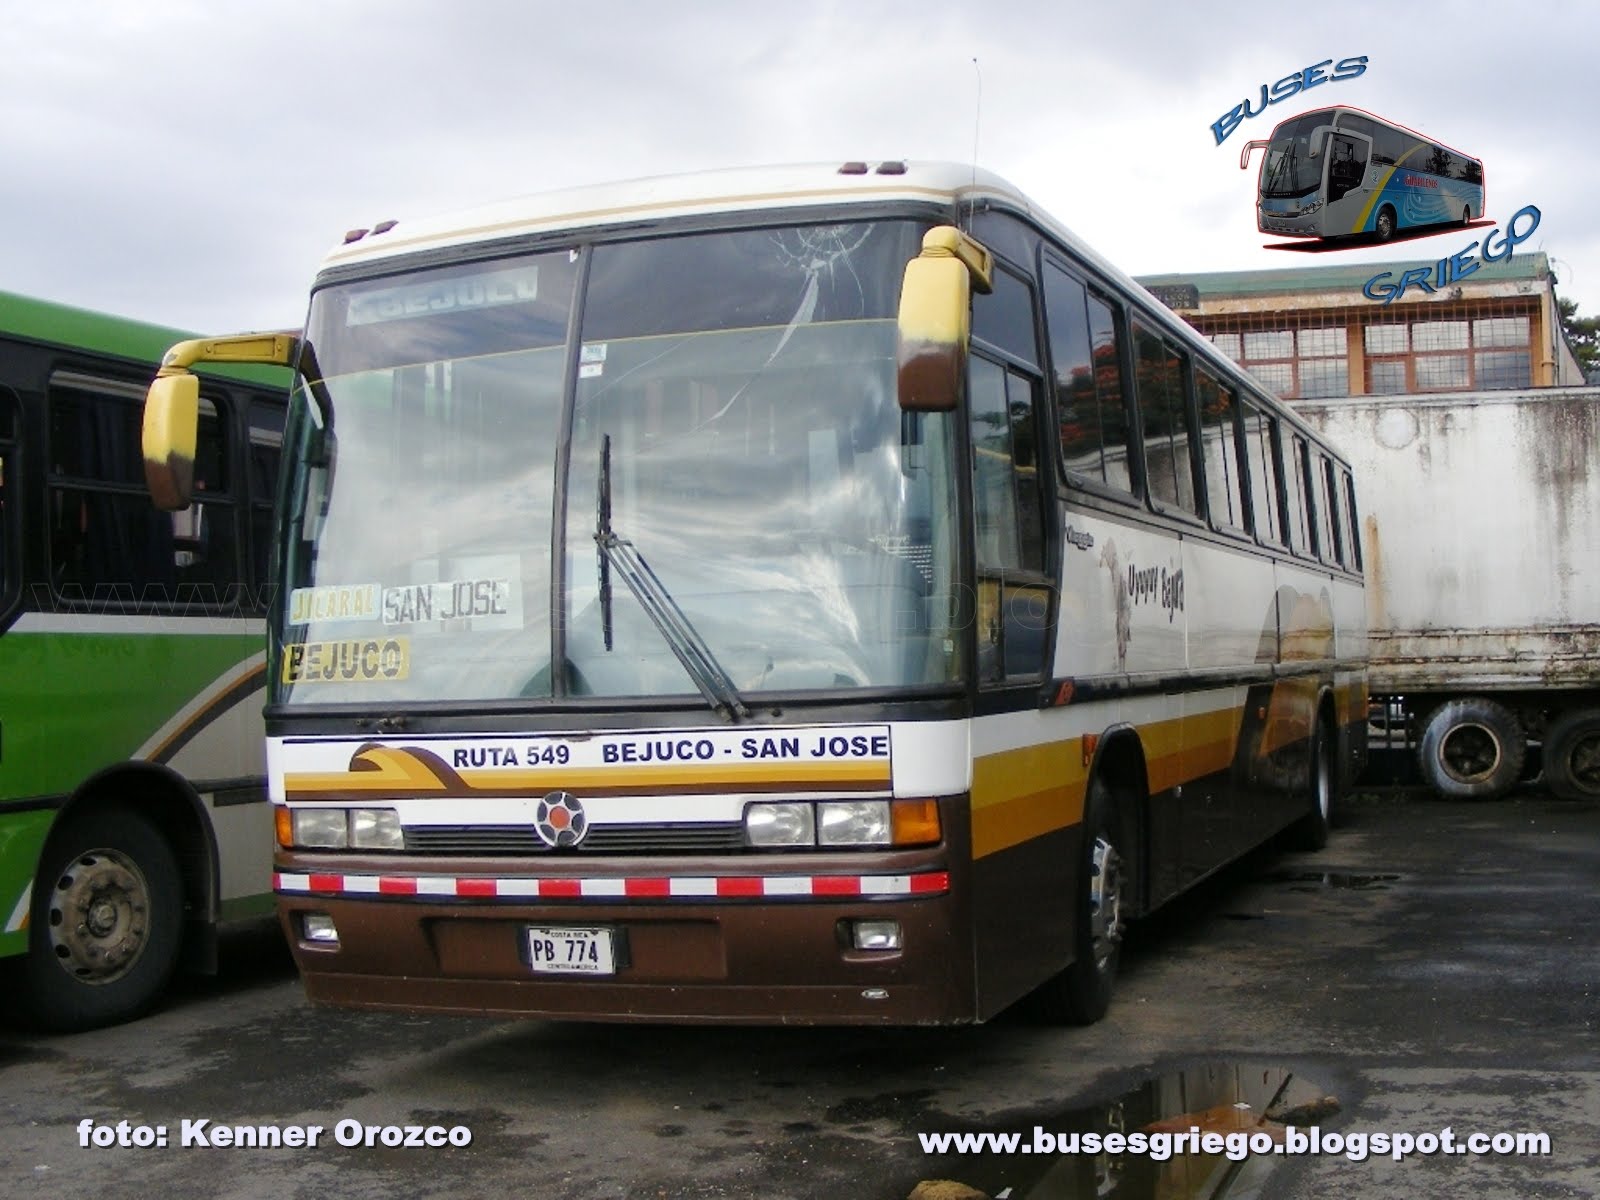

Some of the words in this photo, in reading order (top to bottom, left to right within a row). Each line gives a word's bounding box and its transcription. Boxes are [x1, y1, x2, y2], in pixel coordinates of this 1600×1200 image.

[385, 584, 432, 624] SAN
[441, 579, 507, 620] JOSE
[289, 640, 401, 681] BEJUCO
[454, 747, 518, 767] RUTA
[527, 744, 570, 765] 549
[603, 740, 714, 763] BEJUCO
[742, 738, 799, 758] SAN
[811, 736, 888, 757] JOSE
[533, 940, 555, 961] PB
[565, 940, 598, 962] 774
